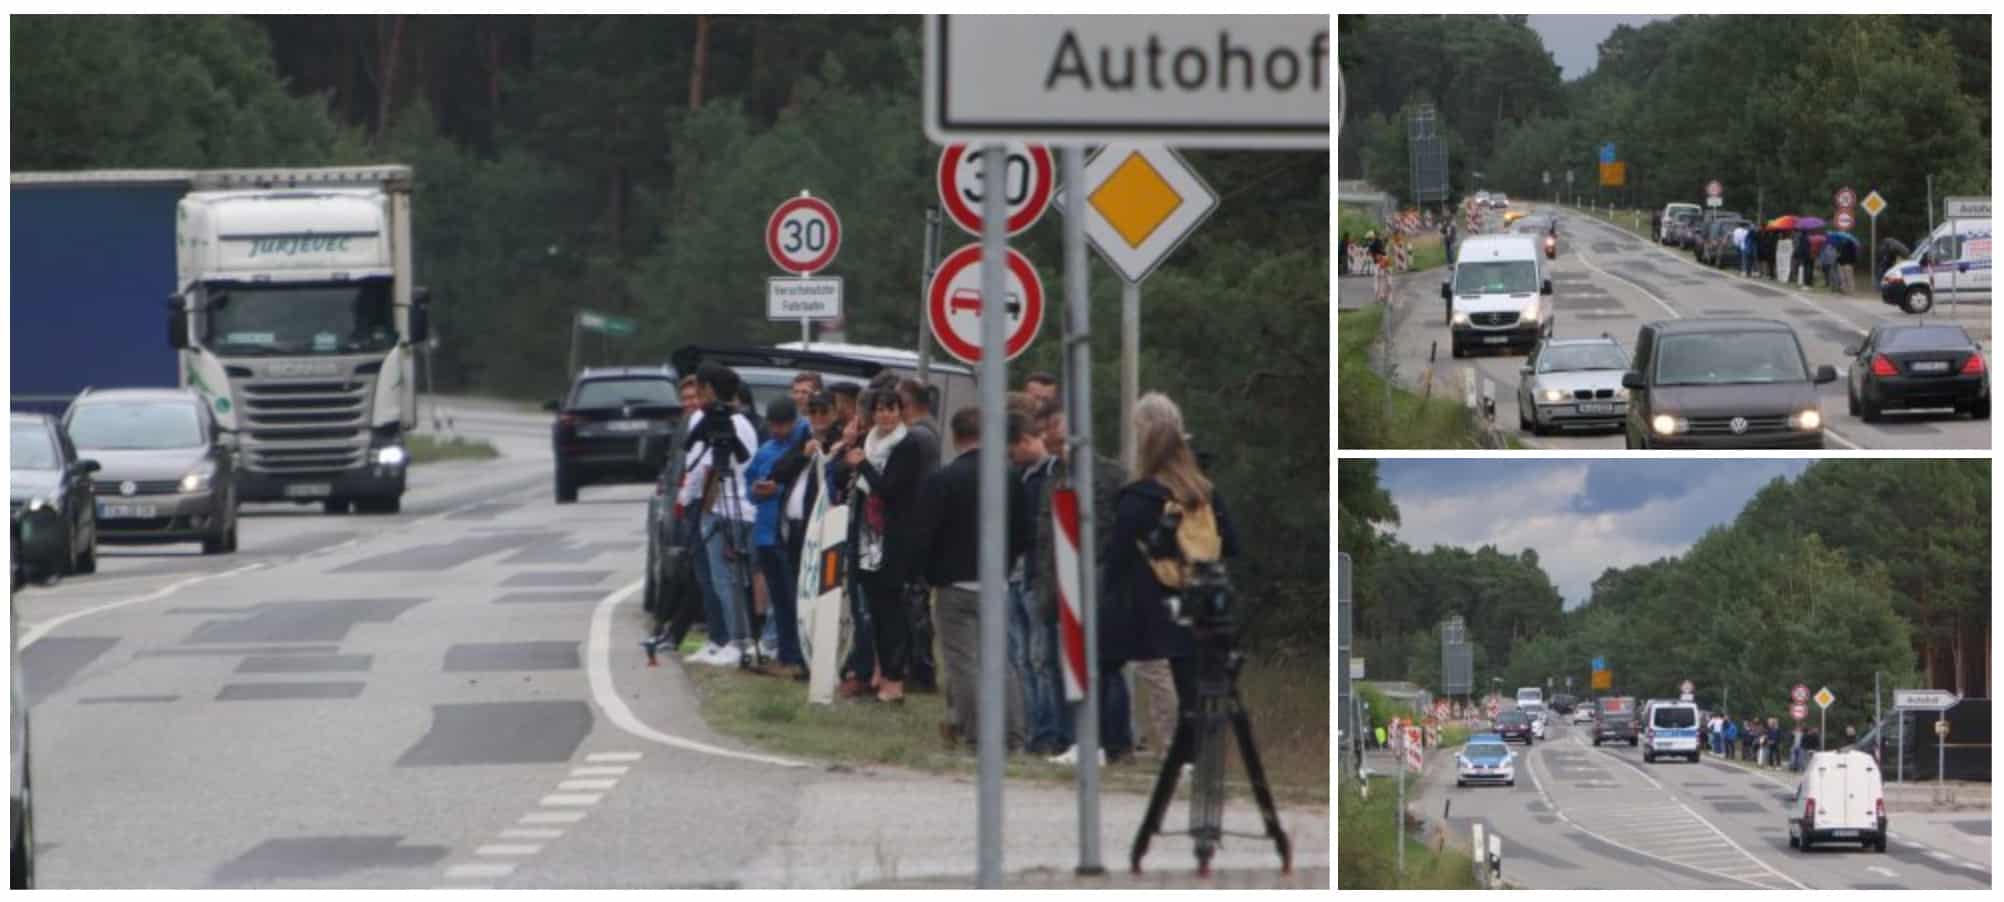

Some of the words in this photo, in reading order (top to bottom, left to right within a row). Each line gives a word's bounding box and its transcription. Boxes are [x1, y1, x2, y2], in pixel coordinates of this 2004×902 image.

[1044, 29, 1329, 91] Autohof
[964, 151, 1030, 206] 30
[784, 219, 825, 252] 30
